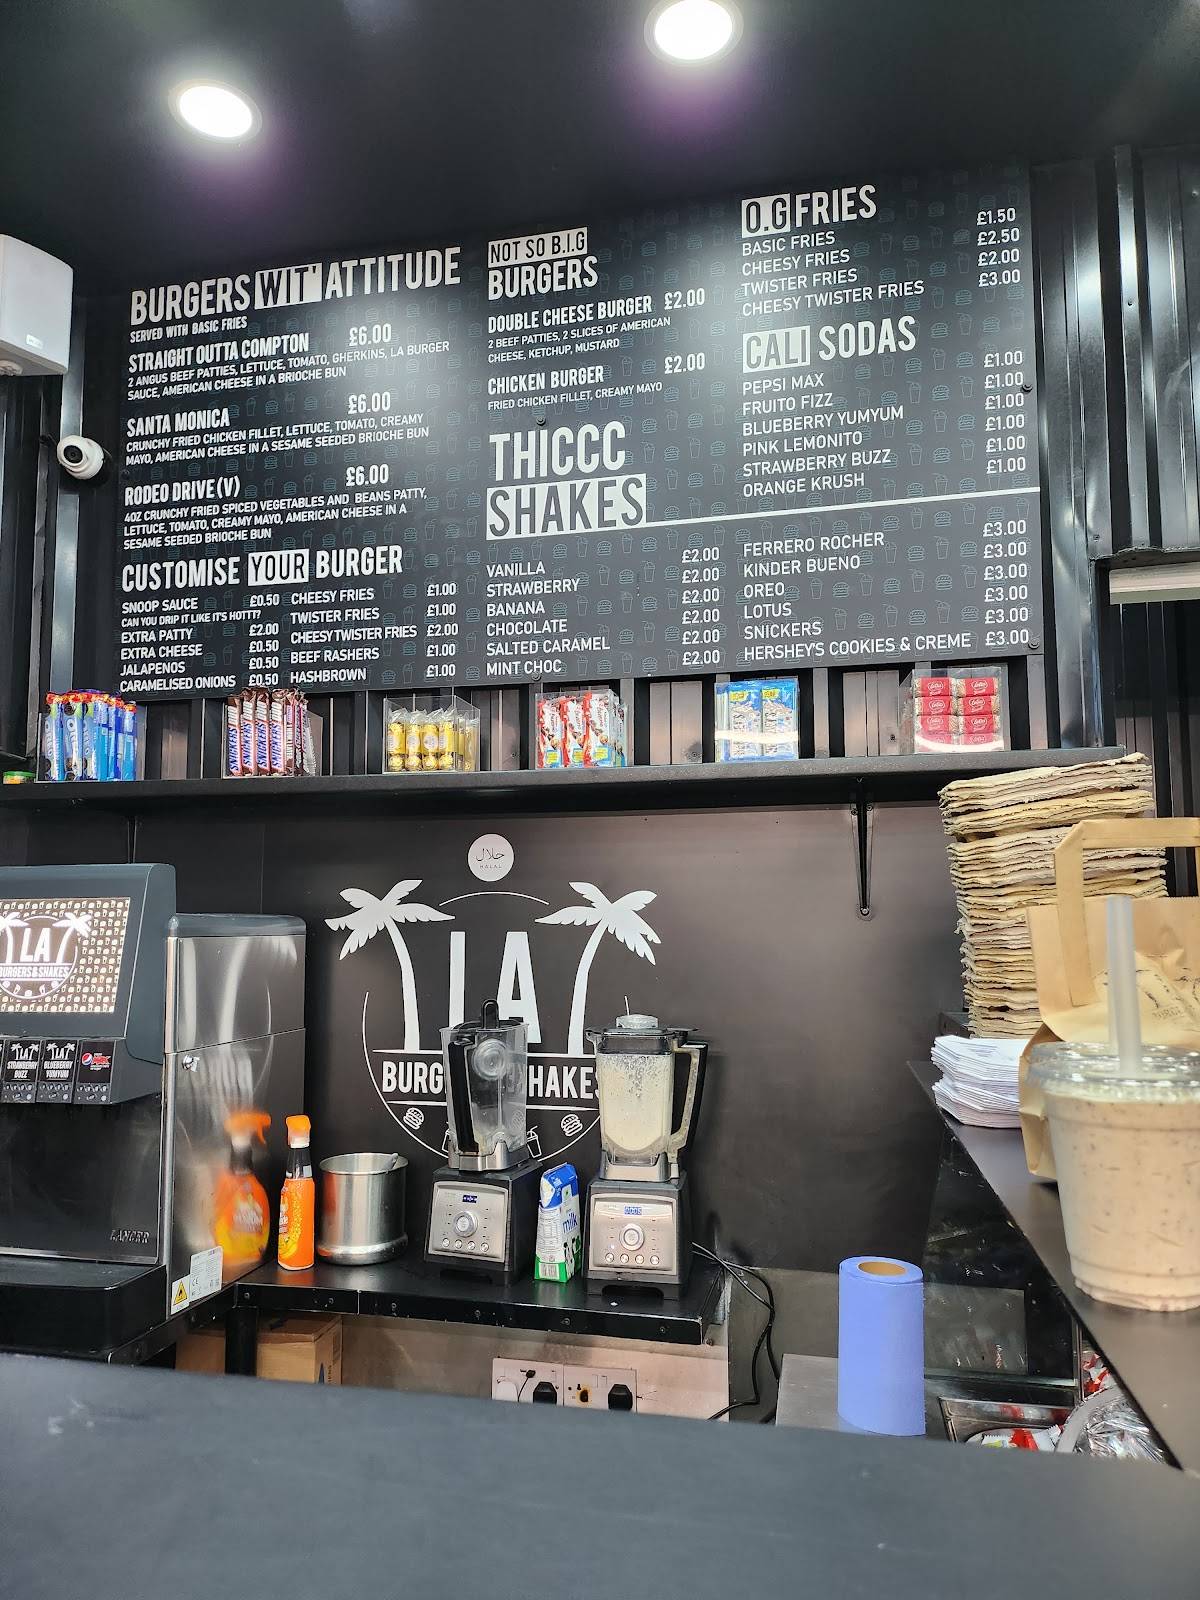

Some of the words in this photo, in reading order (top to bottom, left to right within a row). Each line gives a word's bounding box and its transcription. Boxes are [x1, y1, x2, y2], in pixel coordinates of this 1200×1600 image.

[796, 184, 876, 228] FRIES
[977, 208, 1016, 226] £1.50
[742, 238, 786, 256] BASIC
[791, 231, 835, 250] FRIES
[977, 228, 1020, 246] £2.50
[490, 241, 518, 263] NOT
[526, 237, 545, 258] SO
[978, 249, 1020, 267] £2.00
[742, 256, 800, 276] CHEESY
[806, 250, 850, 268] FRIES
[130, 274, 250, 325] BURGERS
[325, 247, 460, 300] ATTITUDE
[488, 256, 598, 300] BURGERS
[741, 275, 807, 296] TWISTER
[812, 269, 858, 287] FRIES
[979, 269, 1020, 287] £3.00
[664, 288, 705, 310] £2.00
[742, 296, 801, 316] CHEESY
[806, 287, 872, 308] TWISTER
[878, 280, 924, 300] FRIES
[489, 310, 538, 333] DOUBLE
[543, 303, 593, 326] CHEESE
[598, 295, 651, 319] BURGER
[130, 327, 164, 343] SERVED
[168, 324, 190, 338] WITH
[194, 320, 220, 335] BASIC
[223, 316, 247, 331] FRIES
[349, 323, 391, 347] £6.00
[746, 329, 806, 368] CALI
[819, 316, 916, 360] SODAS
[129, 347, 193, 374] STRAIGHT
[196, 342, 238, 365] OUTTA
[242, 333, 309, 360] COMPTON
[664, 353, 705, 374] £2.00
[984, 351, 1022, 368] £1.00
[128, 378, 133, 388] 2
[136, 374, 168, 387] ANGUS
[170, 371, 195, 383] BEEF
[391, 347, 403, 358] LA
[408, 341, 449, 356] BURGER
[488, 372, 545, 395] CHICKEN
[551, 366, 604, 388] BURGER
[742, 378, 786, 396] PEPSI
[792, 373, 824, 390] MAX
[348, 391, 390, 415] £6.00
[488, 399, 514, 411] FRIED
[518, 394, 558, 407] CHICKEN
[596, 385, 634, 399] CREAMY
[637, 382, 662, 394] MAYO
[742, 397, 796, 415] FRUITO
[802, 393, 832, 409] FIZZ
[984, 393, 1024, 410] £1.00
[127, 414, 169, 438] SANTA
[174, 408, 229, 432] MONICA
[743, 414, 833, 436] BLUEBERRY
[838, 406, 903, 427] YUMYUM
[490, 421, 625, 481] THICCC
[743, 440, 780, 456] PINK
[785, 431, 862, 452] LEMONITO
[743, 454, 847, 477] STRAWBERRY
[852, 449, 890, 467] BUZZ
[987, 457, 1026, 474] £1.00
[346, 464, 389, 486] £6.00
[744, 478, 807, 498] ORANGE
[813, 473, 864, 491] KRUSH
[124, 483, 169, 506] RODEO
[489, 478, 643, 537] SHAKES
[983, 520, 1026, 538] £3.00
[682, 547, 719, 563] £2.00
[743, 538, 814, 557] FERRERO
[820, 532, 884, 551] ROCHER
[122, 557, 239, 592] CUSTOMISE
[252, 553, 304, 582] YOUR
[316, 545, 402, 579] BURGER
[486, 561, 544, 578] VANILLA
[744, 560, 800, 577] KINDER
[807, 556, 860, 572] BUENO
[984, 564, 1027, 580] £3.00
[292, 590, 336, 605] CHEESY
[340, 588, 374, 602] FRIES
[427, 583, 456, 597] £1.00
[487, 578, 580, 597] STRAWBERRY
[682, 588, 719, 604] £2.00
[744, 582, 784, 598] OREO
[122, 600, 159, 613] SNOOP
[163, 598, 197, 611] SAUCE
[250, 595, 279, 607] £0.50
[487, 601, 545, 616] BANANA
[744, 602, 791, 618] LOTUS
[122, 618, 138, 627] CAN
[141, 616, 156, 626] YOU
[159, 615, 179, 625] DRIP
[181, 615, 188, 624] IT
[190, 613, 210, 623] LIKE
[291, 610, 341, 624] TWISTER
[345, 608, 379, 621] FRIES
[121, 631, 156, 644] EXTRA
[160, 628, 193, 641] PATTY
[250, 624, 278, 636] £2.00
[427, 624, 458, 636] £2.00
[487, 619, 567, 636] CHOCOLATE
[744, 622, 822, 640] SNICKERS
[985, 629, 1029, 646] £3.00
[487, 640, 538, 657] SALTED
[543, 637, 610, 653] CARAMEL
[830, 638, 896, 656] COOKIES
[900, 637, 910, 651] &
[916, 633, 971, 650] CREME
[291, 651, 320, 664] BEEF
[324, 648, 379, 662] RASHERS
[682, 650, 720, 666] £2.00
[120, 662, 185, 676] JALAPENOS
[291, 668, 366, 684] HASHBROWN
[427, 664, 455, 678] £1.00
[487, 661, 519, 675] MINT
[523, 659, 561, 674] CHOC
[120, 678, 193, 693] CARAMELISED
[196, 676, 236, 689] ONIONS
[249, 674, 278, 686] £0.50
[228, 728, 239, 770] SNICKERS
[243, 722, 251, 766] SNICKERS
[257, 723, 267, 767] SNICKERS
[272, 724, 281, 768] SNICKERS
[20, 928, 50, 962] LA
[563, 1211, 578, 1233] milk
